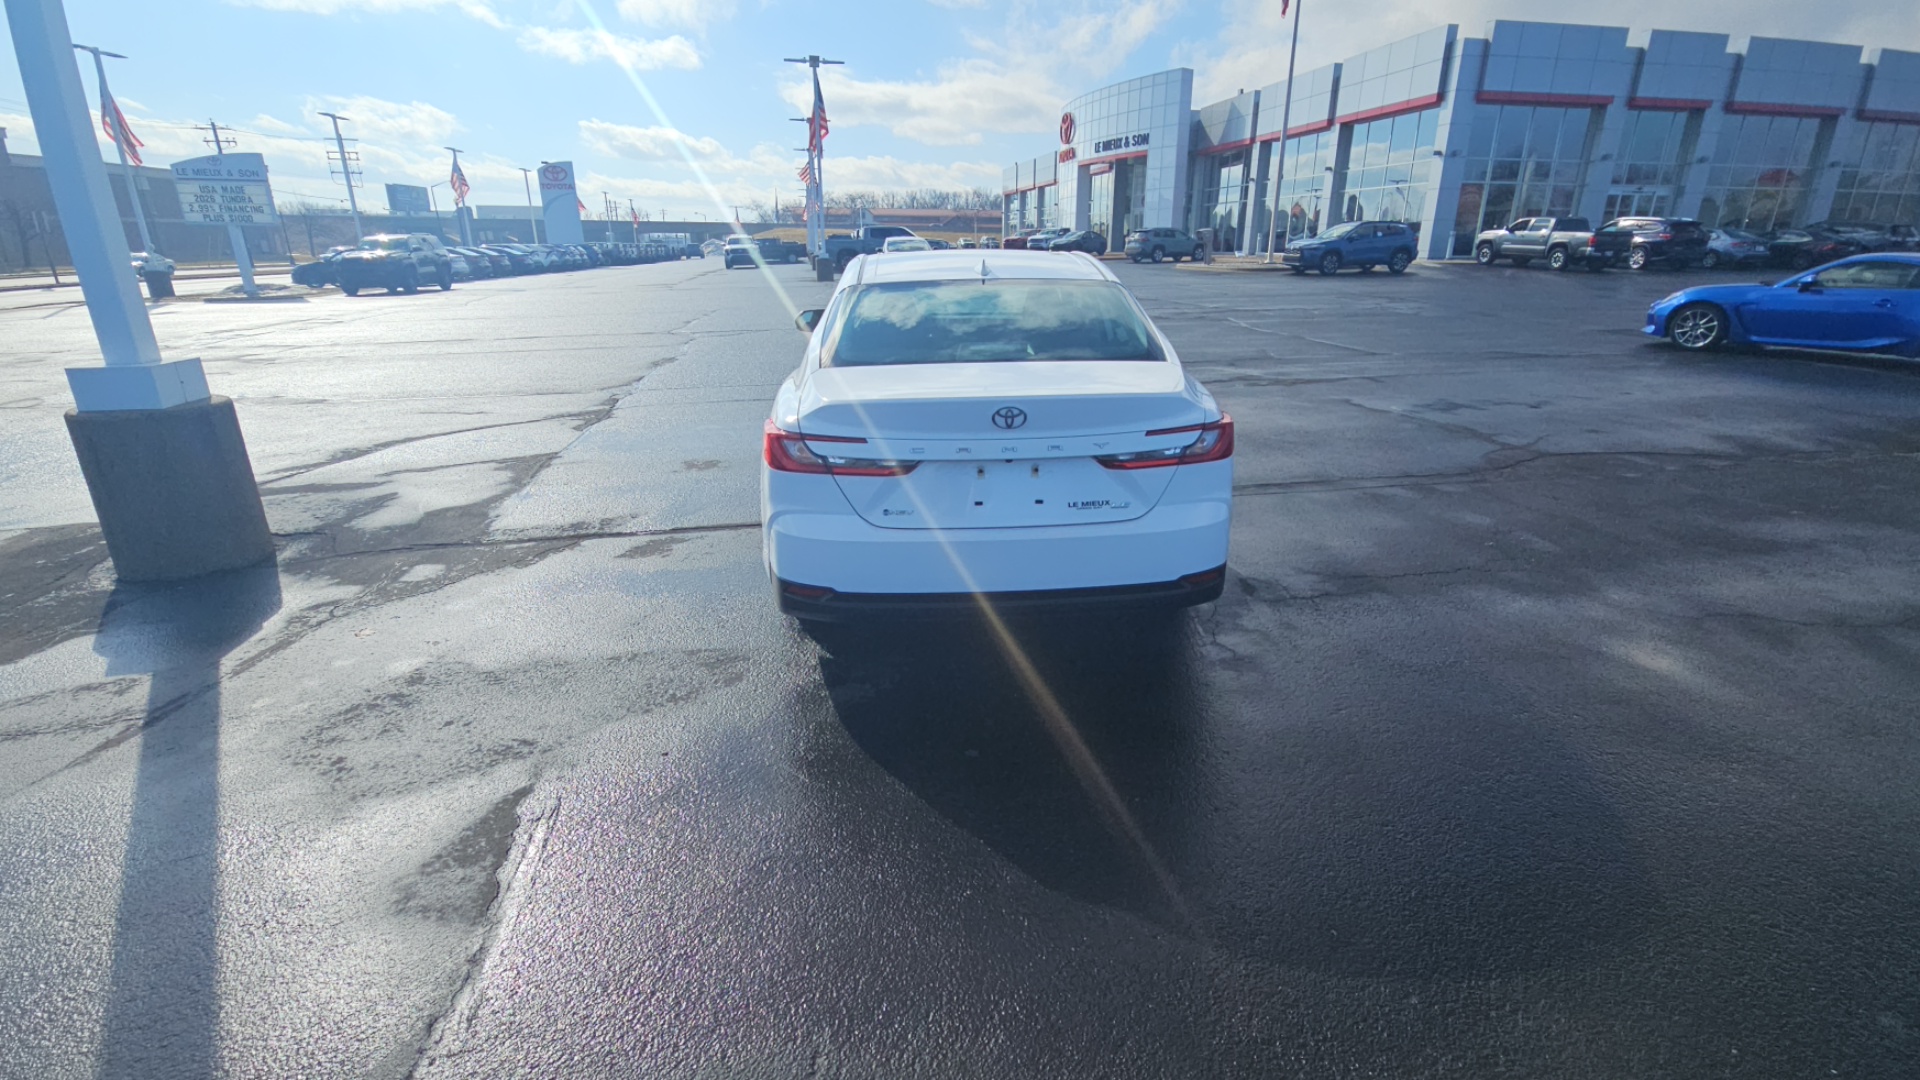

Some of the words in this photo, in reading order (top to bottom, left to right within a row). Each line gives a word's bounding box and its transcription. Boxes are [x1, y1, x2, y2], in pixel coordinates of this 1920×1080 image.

[1095, 142, 1102, 153] LE
[1102, 137, 1123, 152] MIEUX
[1124, 136, 1130, 148] &
[1132, 133, 1150, 147] SON
[176, 168, 188, 176] LE
[192, 168, 222, 177] MIEUX
[227, 169, 233, 177] &
[238, 170, 260, 178] SON
[199, 185, 218, 194] USA
[221, 186, 246, 195] MADE
[220, 196, 253, 204] TUNDRA
[219, 205, 265, 214] FINANCING
[203, 214, 225, 222] PLUS
[229, 214, 254, 223] $1000
